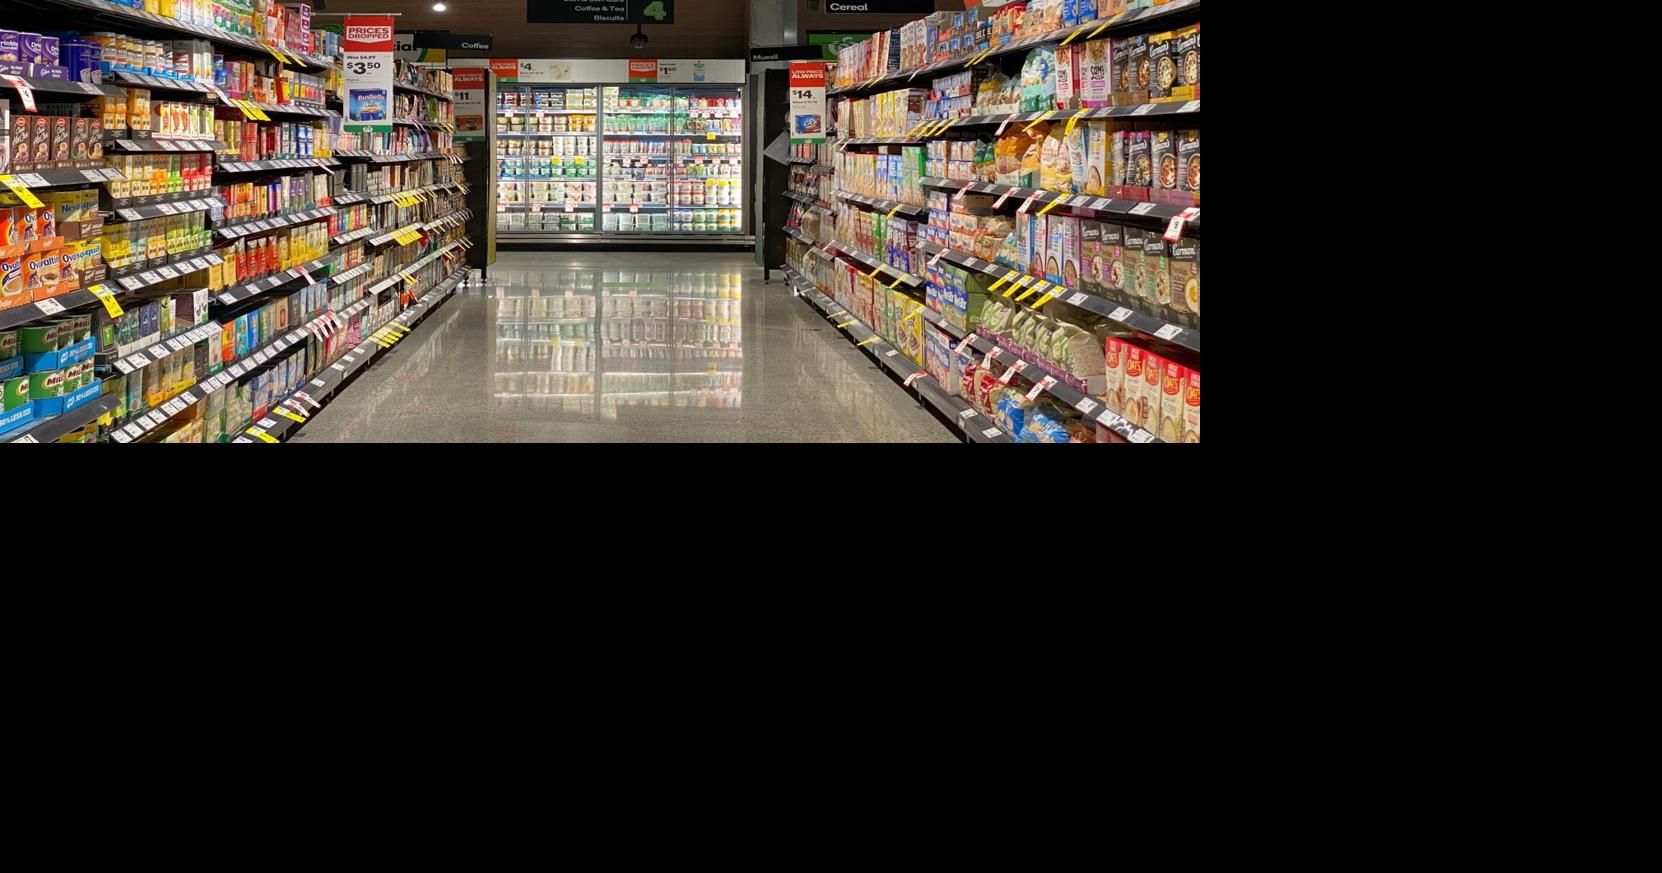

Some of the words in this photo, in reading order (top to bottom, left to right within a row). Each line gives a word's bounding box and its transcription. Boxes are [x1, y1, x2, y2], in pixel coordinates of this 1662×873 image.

[643, 0, 666, 21] 4
[829, 2, 869, 11] Cereal
[454, 92, 470, 100] $11
[792, 89, 813, 99] $14
[1127, 359, 1142, 370] OATS
[1146, 367, 1159, 379] OATS
[1164, 375, 1180, 388] OATS
